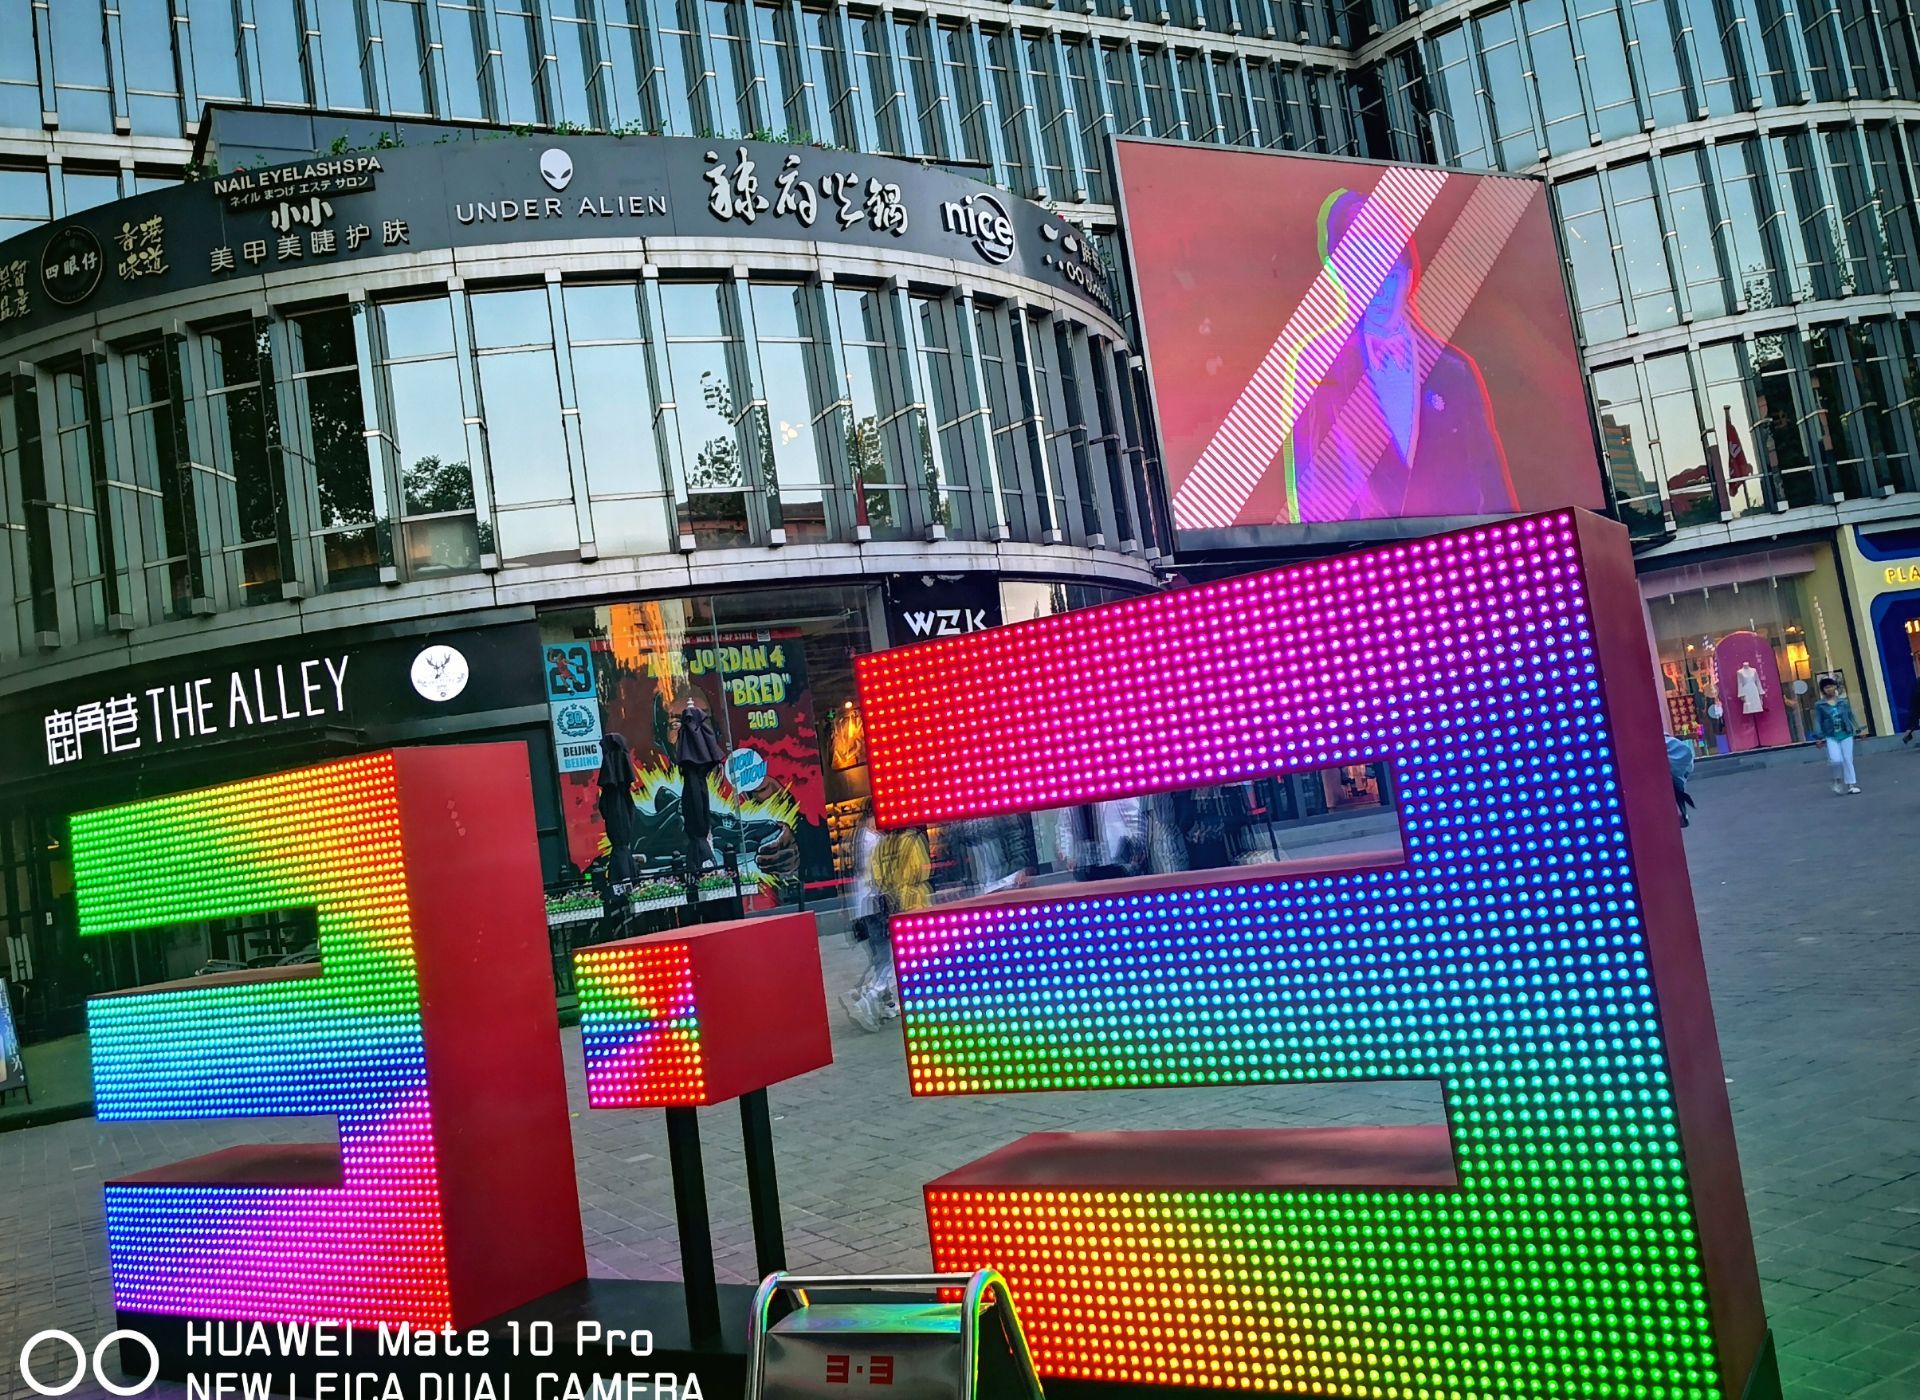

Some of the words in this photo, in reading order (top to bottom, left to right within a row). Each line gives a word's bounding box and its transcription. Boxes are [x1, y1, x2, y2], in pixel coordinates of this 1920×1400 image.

[213, 175, 255, 195] NAIL
[299, 179, 332, 194] エステ
[335, 175, 369, 189] サロン
[271, 197, 334, 232] 小小
[456, 197, 562, 223] UNDER
[578, 195, 667, 216] ALIEN
[944, 194, 1013, 246] nice
[209, 218, 409, 273] 美甲美睫护肤
[45, 251, 98, 280] 四眼仔
[903, 608, 988, 636] WZK
[547, 647, 592, 694] 23
[690, 645, 769, 676] JORDAN
[769, 645, 786, 668] 4
[45, 693, 141, 765] 鹿角巷
[145, 678, 218, 743] THE
[229, 655, 349, 728] ALLEY
[748, 709, 779, 730] 2019
[563, 744, 598, 757] BEIJING
[564, 755, 599, 769] BEIJING
